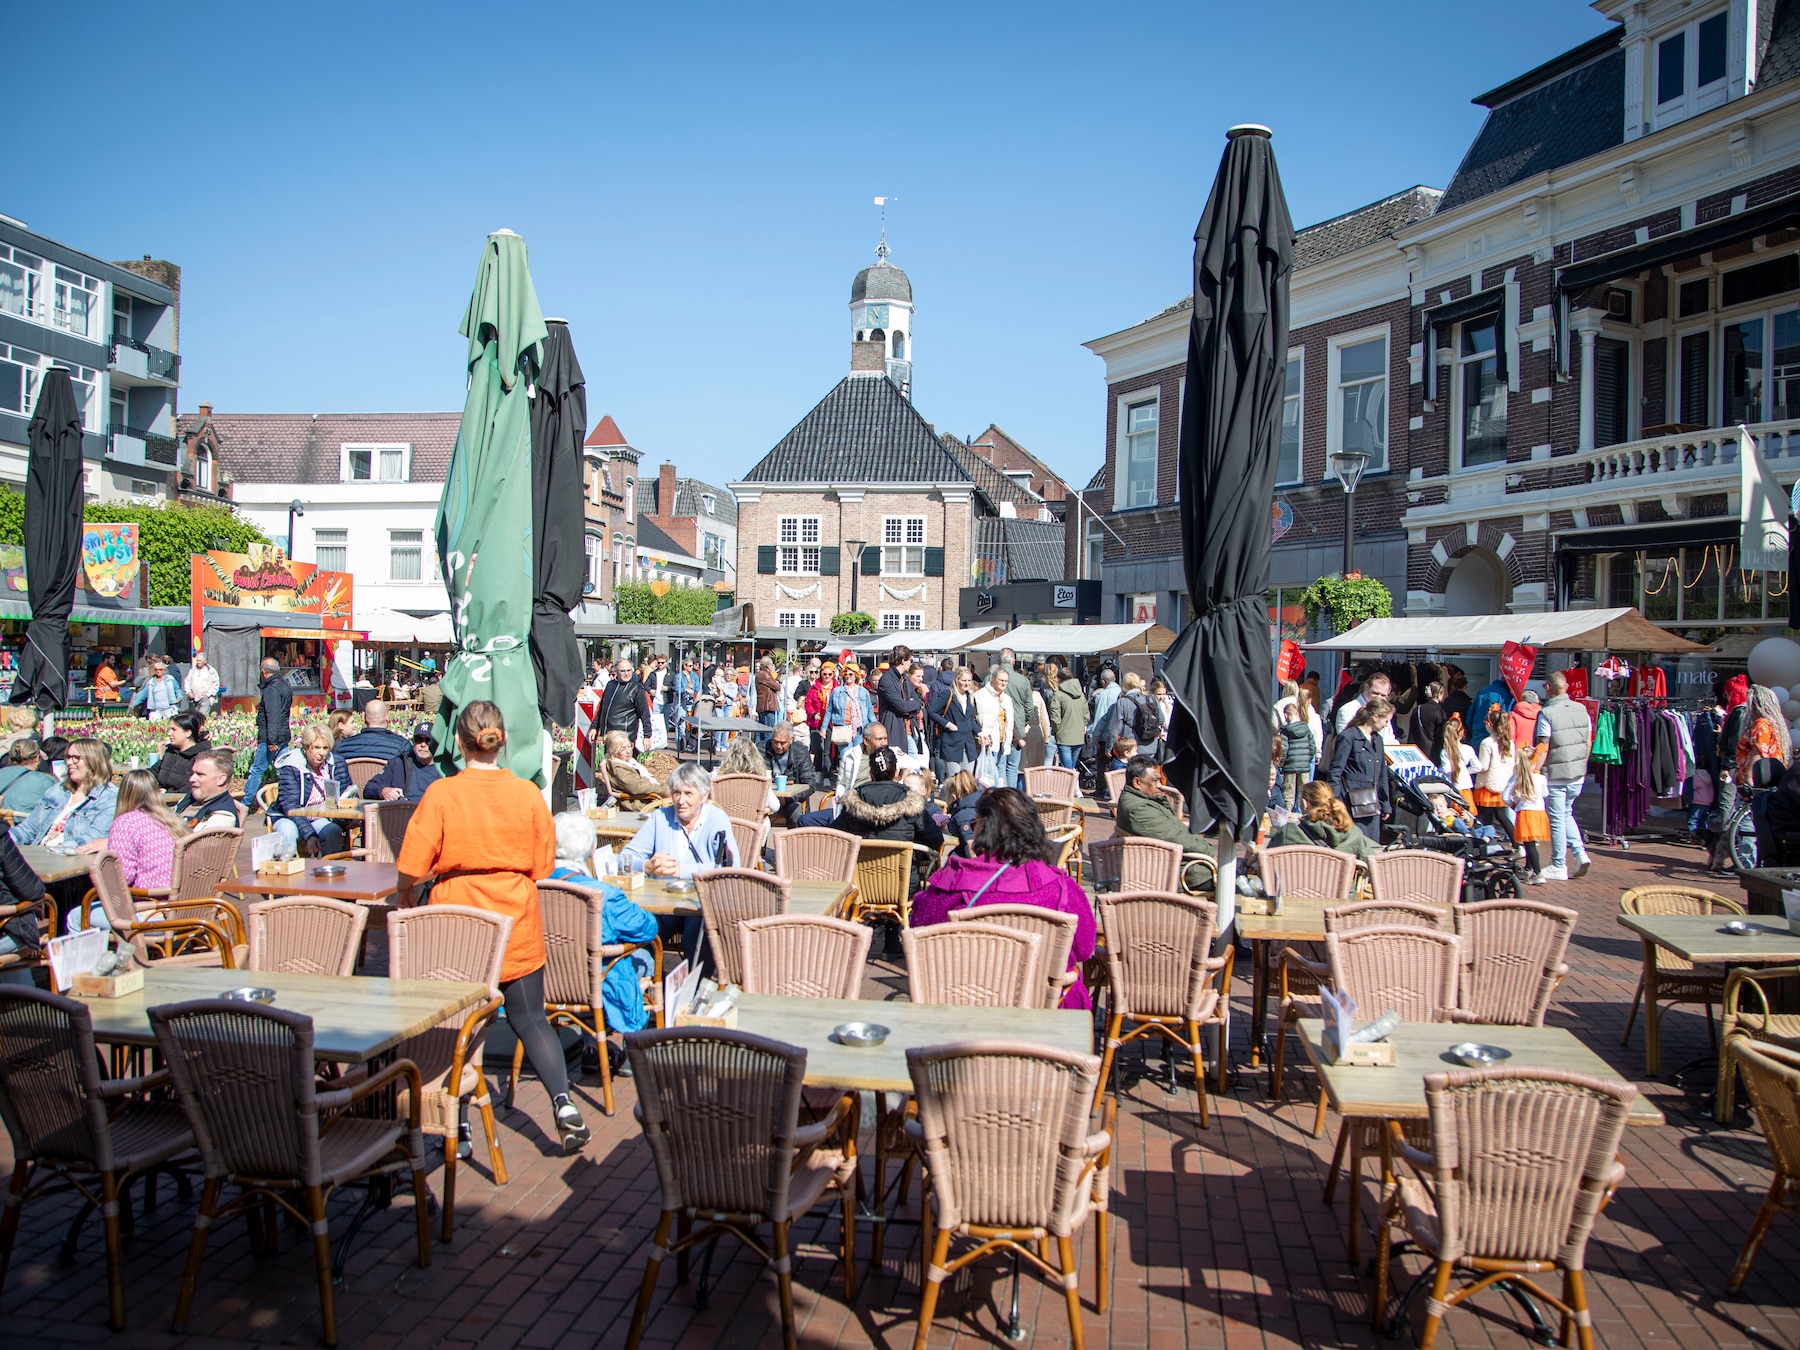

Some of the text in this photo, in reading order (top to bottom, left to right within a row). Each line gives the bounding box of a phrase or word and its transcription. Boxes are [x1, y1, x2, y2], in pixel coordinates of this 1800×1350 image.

[1742, 548, 1784, 567] mate
[233, 569, 260, 589] Sweet
[1058, 587, 1074, 599] Etos
[1677, 670, 1718, 685] mate
